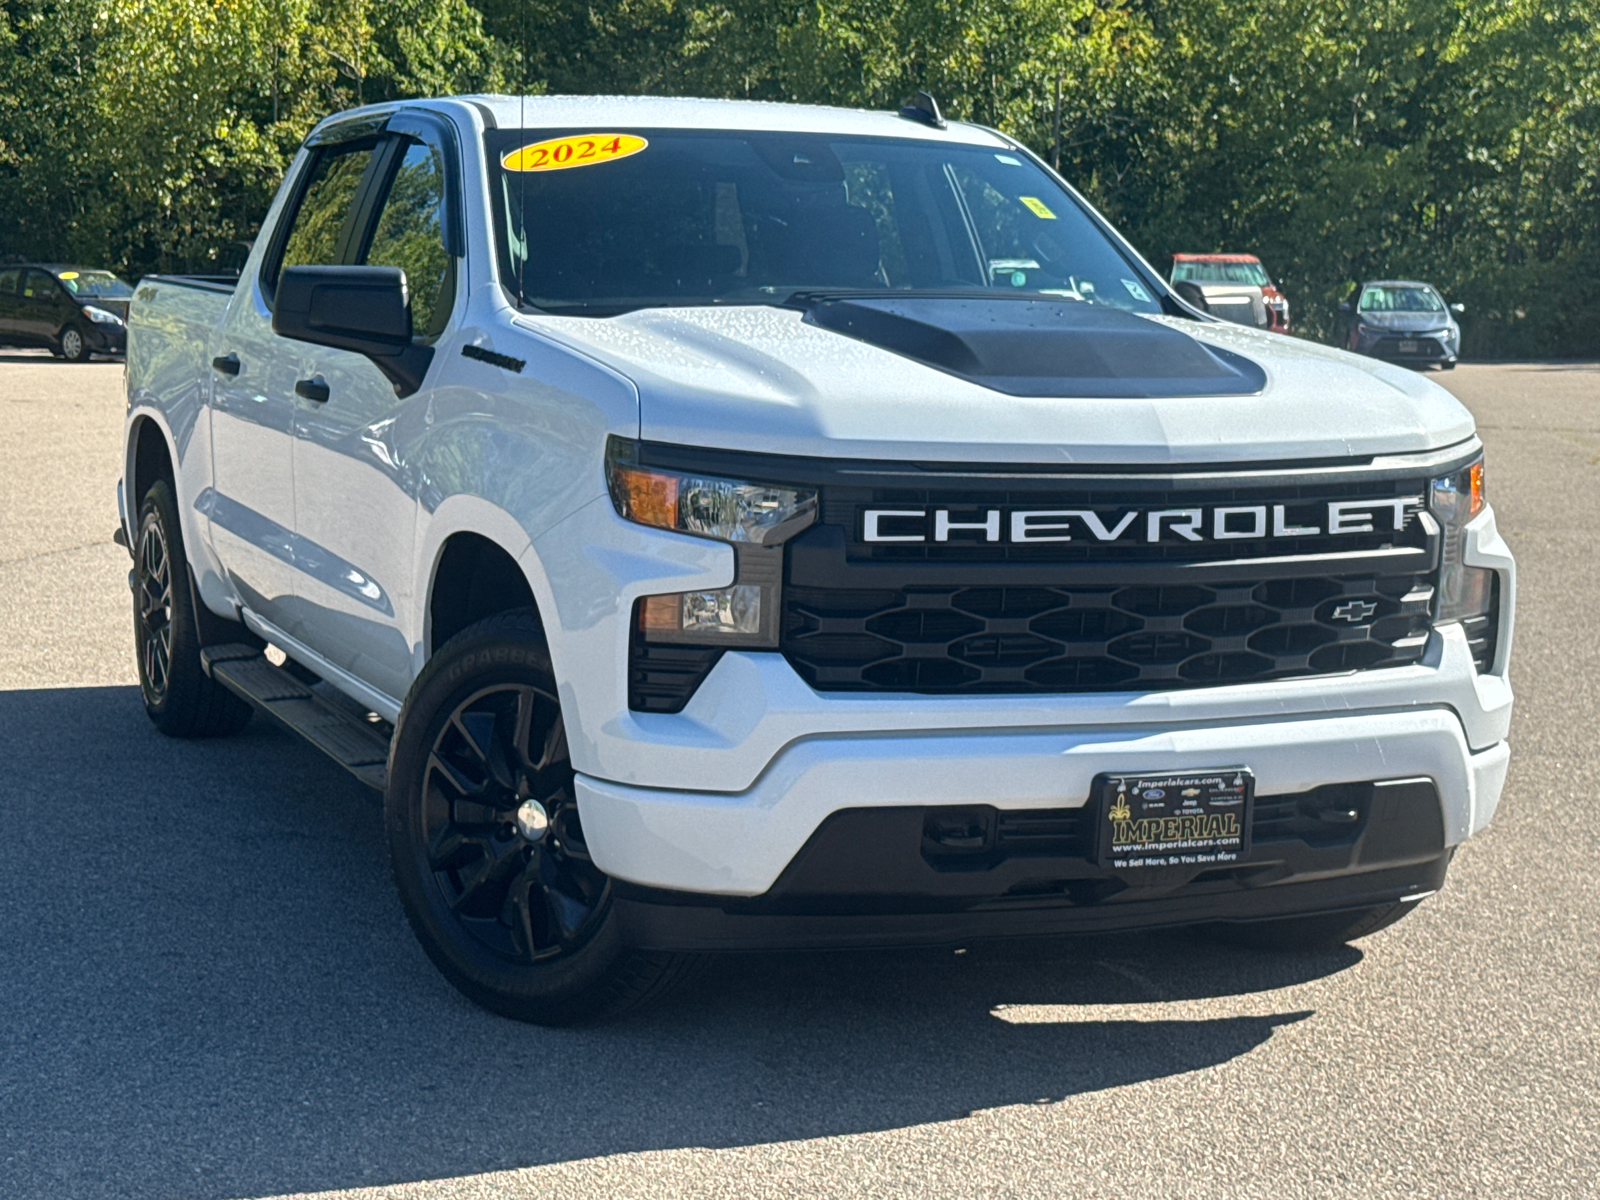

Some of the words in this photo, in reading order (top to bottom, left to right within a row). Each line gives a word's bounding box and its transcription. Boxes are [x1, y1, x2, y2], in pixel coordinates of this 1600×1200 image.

[530, 137, 622, 168] 2024
[863, 497, 1422, 542] CHEVROLET
[1112, 813, 1241, 844] IMPERIAL
[1112, 837, 1240, 853] www.imperialcars.com
[1114, 859, 1127, 868] We
[1129, 858, 1144, 867] Sell
[1169, 856, 1179, 865] So
[1181, 854, 1196, 864] You
[1197, 853, 1216, 863] Save
[1217, 851, 1237, 861] More
